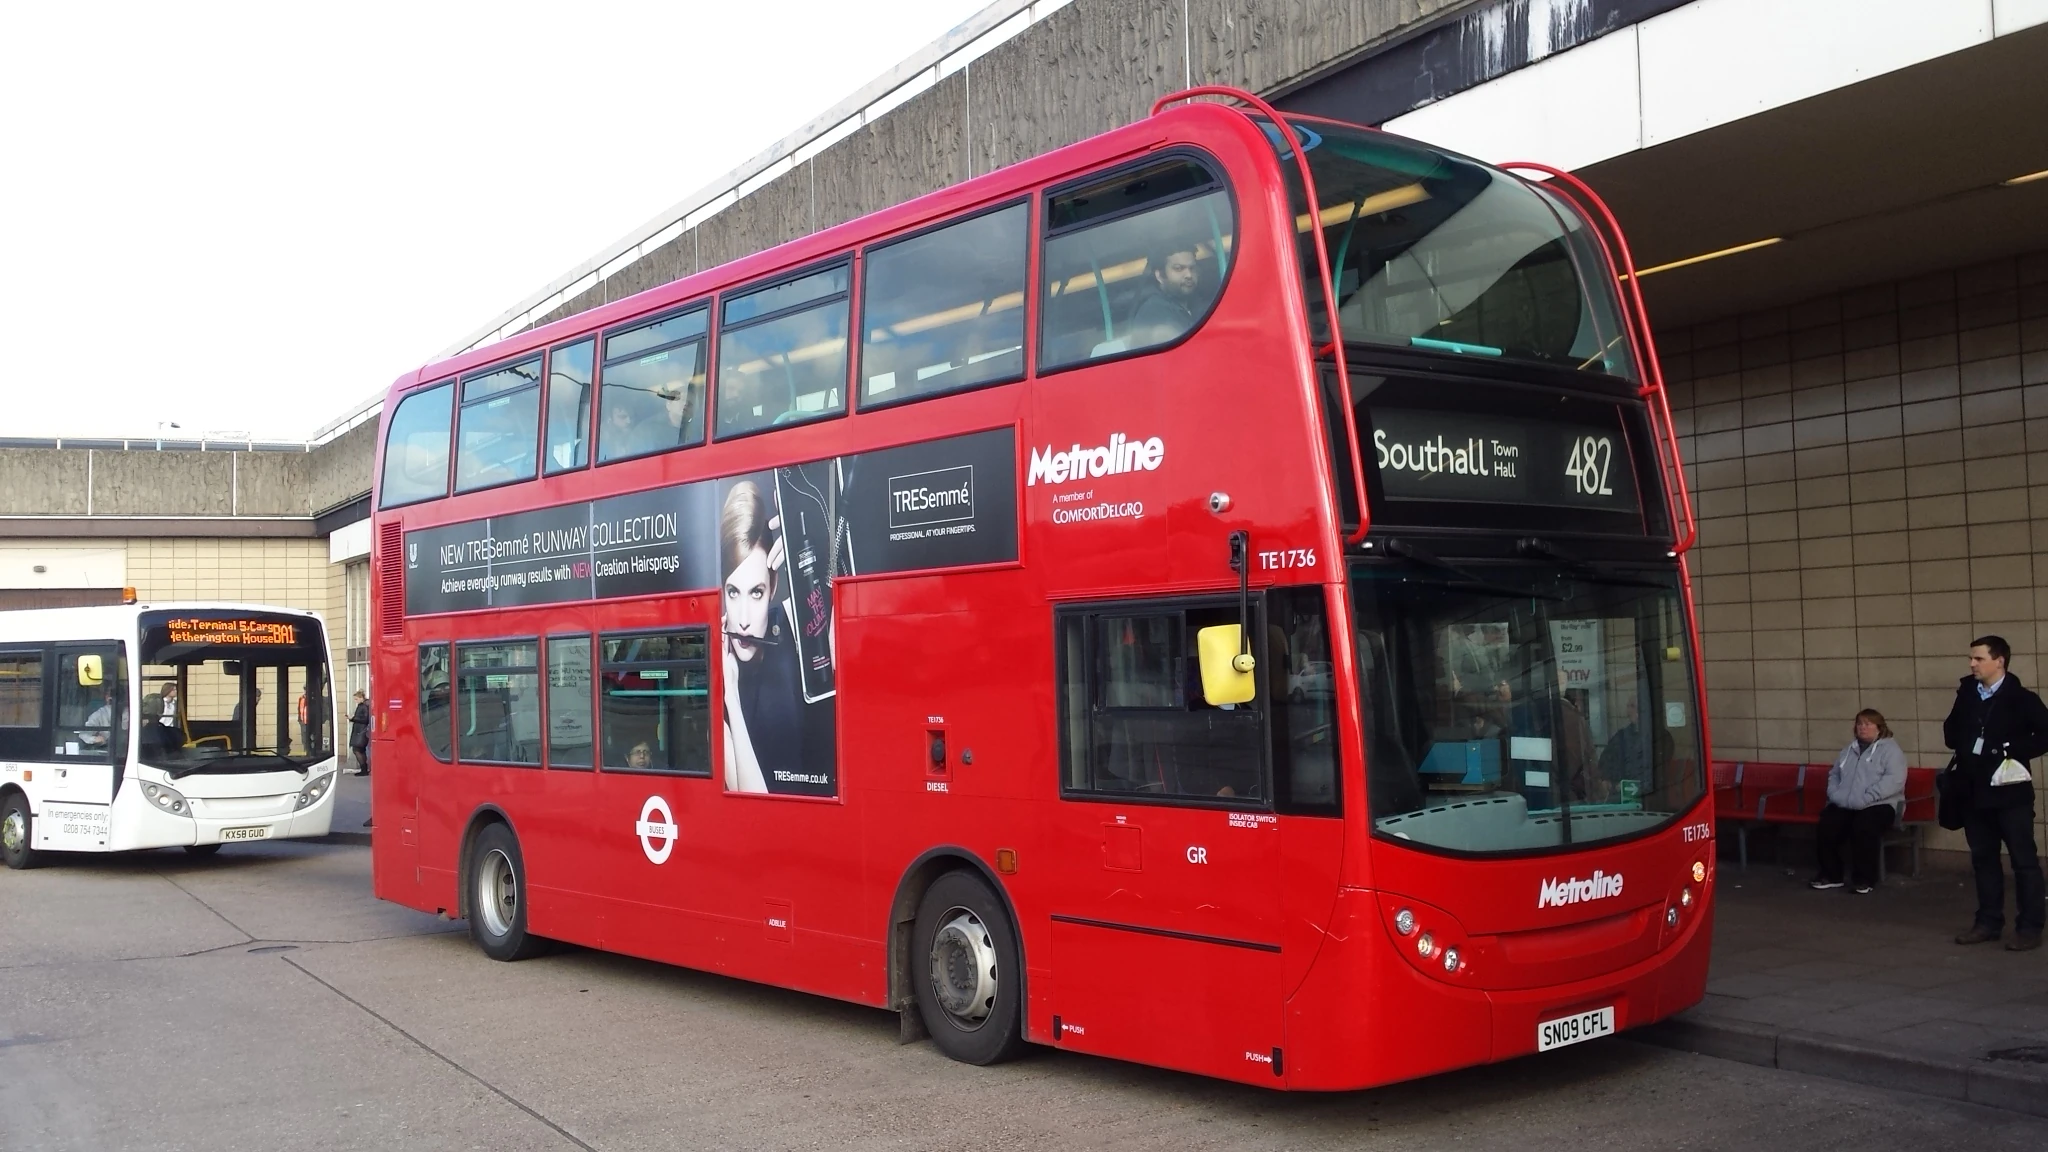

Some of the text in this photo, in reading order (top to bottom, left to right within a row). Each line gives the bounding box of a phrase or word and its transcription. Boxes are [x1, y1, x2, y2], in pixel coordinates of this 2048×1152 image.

[1373, 429, 1489, 476] Southall
[1491, 439, 1519, 458] Town
[1027, 432, 1165, 487] Metroline
[1565, 436, 1613, 496] 482
[1494, 461, 1517, 479] Hall
[892, 481, 970, 513] TRESemmé
[1052, 489, 1094, 504] A member of
[440, 511, 678, 566] NEW TRESemmé RUNWAY COLLECTION
[1258, 548, 1317, 570] TE1736
[441, 554, 680, 594] Achieve everyday runway results with NEW Creation Hairsprays
[243, 632, 274, 645] House
[272, 624, 295, 644] BA1
[773, 770, 829, 785] TRESemme.co.uk
[926, 782, 949, 792] DIESEL
[47, 808, 54, 818] In
[54, 810, 93, 822] emergencies
[1228, 813, 1277, 824] ISOLATOR SWITCH
[1228, 819, 1259, 829] INSIDE CAB
[63, 823, 108, 836] 0208 754 7344
[225, 828, 265, 839] KX58 GUO
[648, 825, 665, 835] BUSES
[1682, 822, 1711, 843] TE1736
[1186, 846, 1208, 865] GR
[1538, 869, 1624, 909] Metroline
[768, 918, 787, 929] ADBLUE
[1069, 1024, 1085, 1035] PUSH
[1543, 1011, 1608, 1047] SN09 CFL
[1245, 1051, 1264, 1063] PUSH
